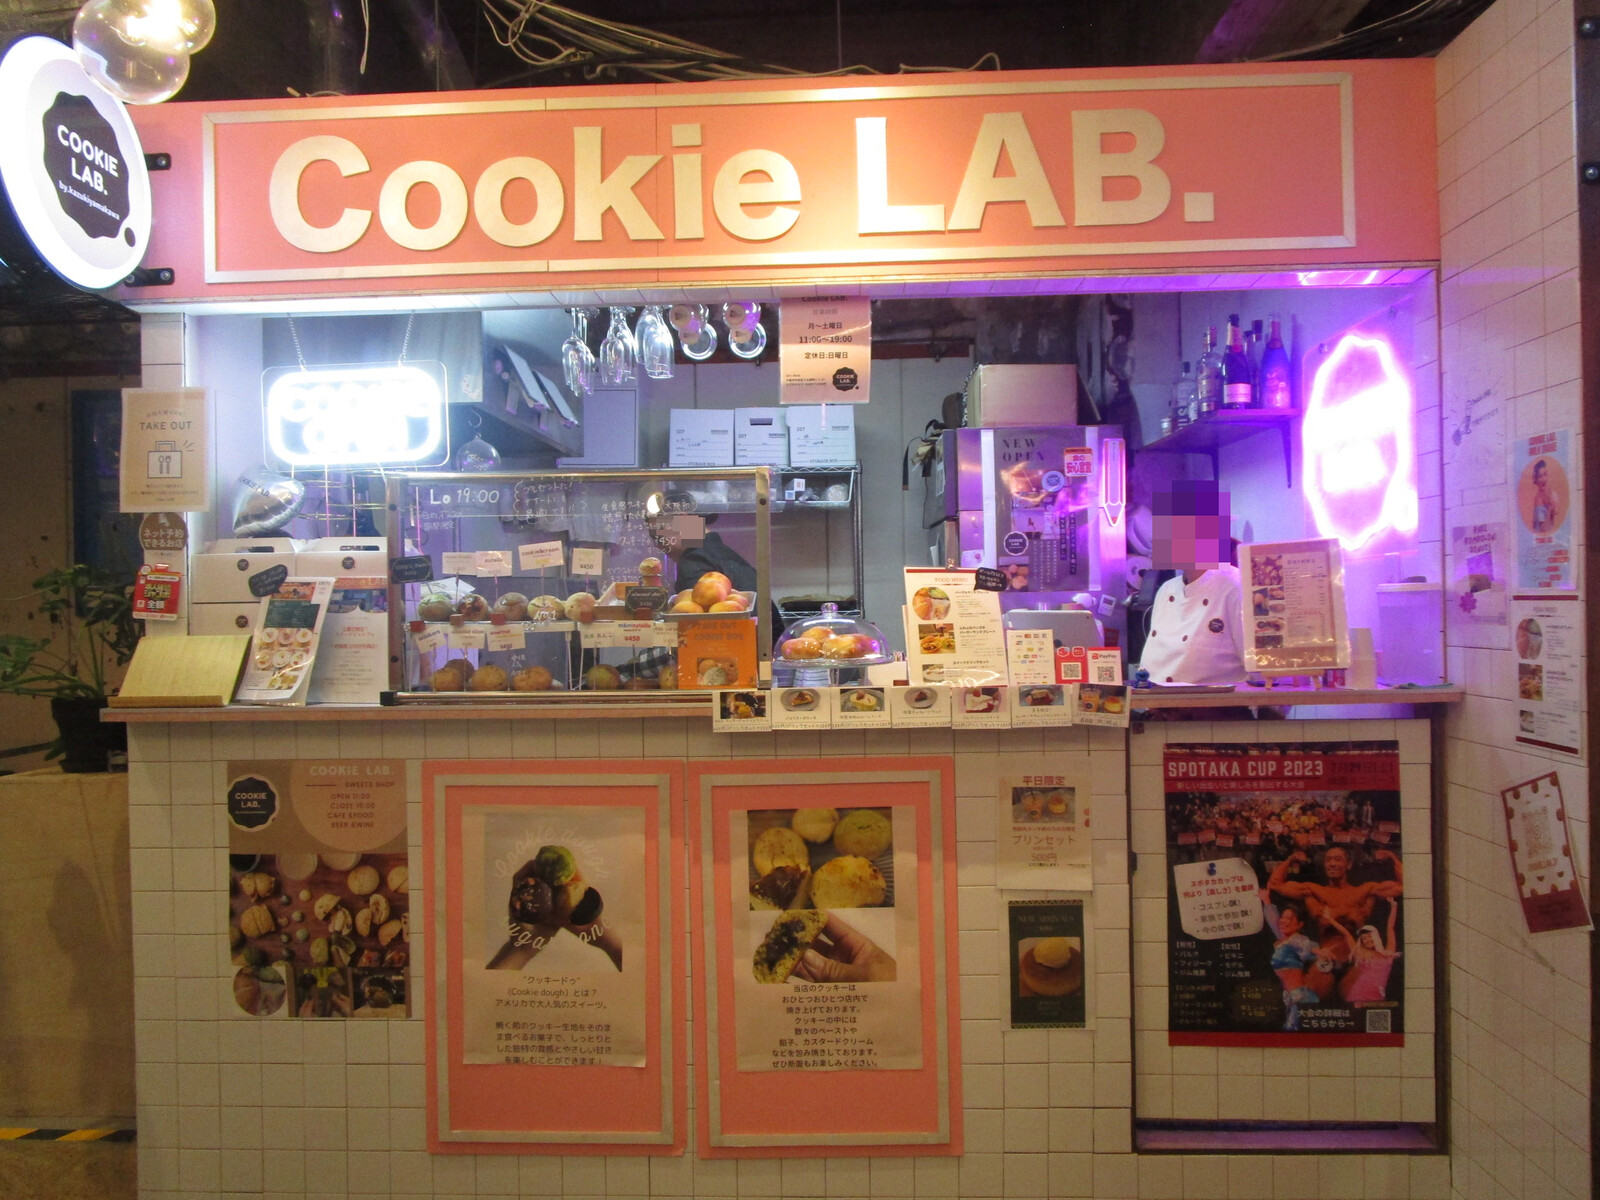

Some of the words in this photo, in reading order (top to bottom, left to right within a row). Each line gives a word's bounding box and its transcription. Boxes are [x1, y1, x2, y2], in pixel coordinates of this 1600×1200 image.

[57, 124, 119, 178] COOKIE
[71, 157, 108, 195] LAB.
[269, 124, 802, 253] Cookie
[856, 108, 1214, 235] LAB.
[140, 421, 167, 430] TAKE
[170, 421, 192, 430] OUT
[1002, 438, 1037, 449] NEW
[1002, 451, 1045, 462] OPEN
[457, 487, 500, 504] 19:00
[310, 765, 359, 776] COOKIE
[366, 765, 394, 776] LAB.
[1168, 761, 1239, 777] SPOTAKA
[1247, 761, 1278, 777] CUP
[1283, 760, 1324, 776] 2023
[330, 802, 353, 810] CLOSE
[793, 984, 857, 993] 当店のクッキーは
[495, 999, 608, 1010] アメリカで大人気のスイーツ。
[782, 994, 869, 1004] おひとつおひとつ店内で
[786, 1005, 860, 1015] 焼き上げております。
[794, 1016, 857, 1025] クッキーの中には
